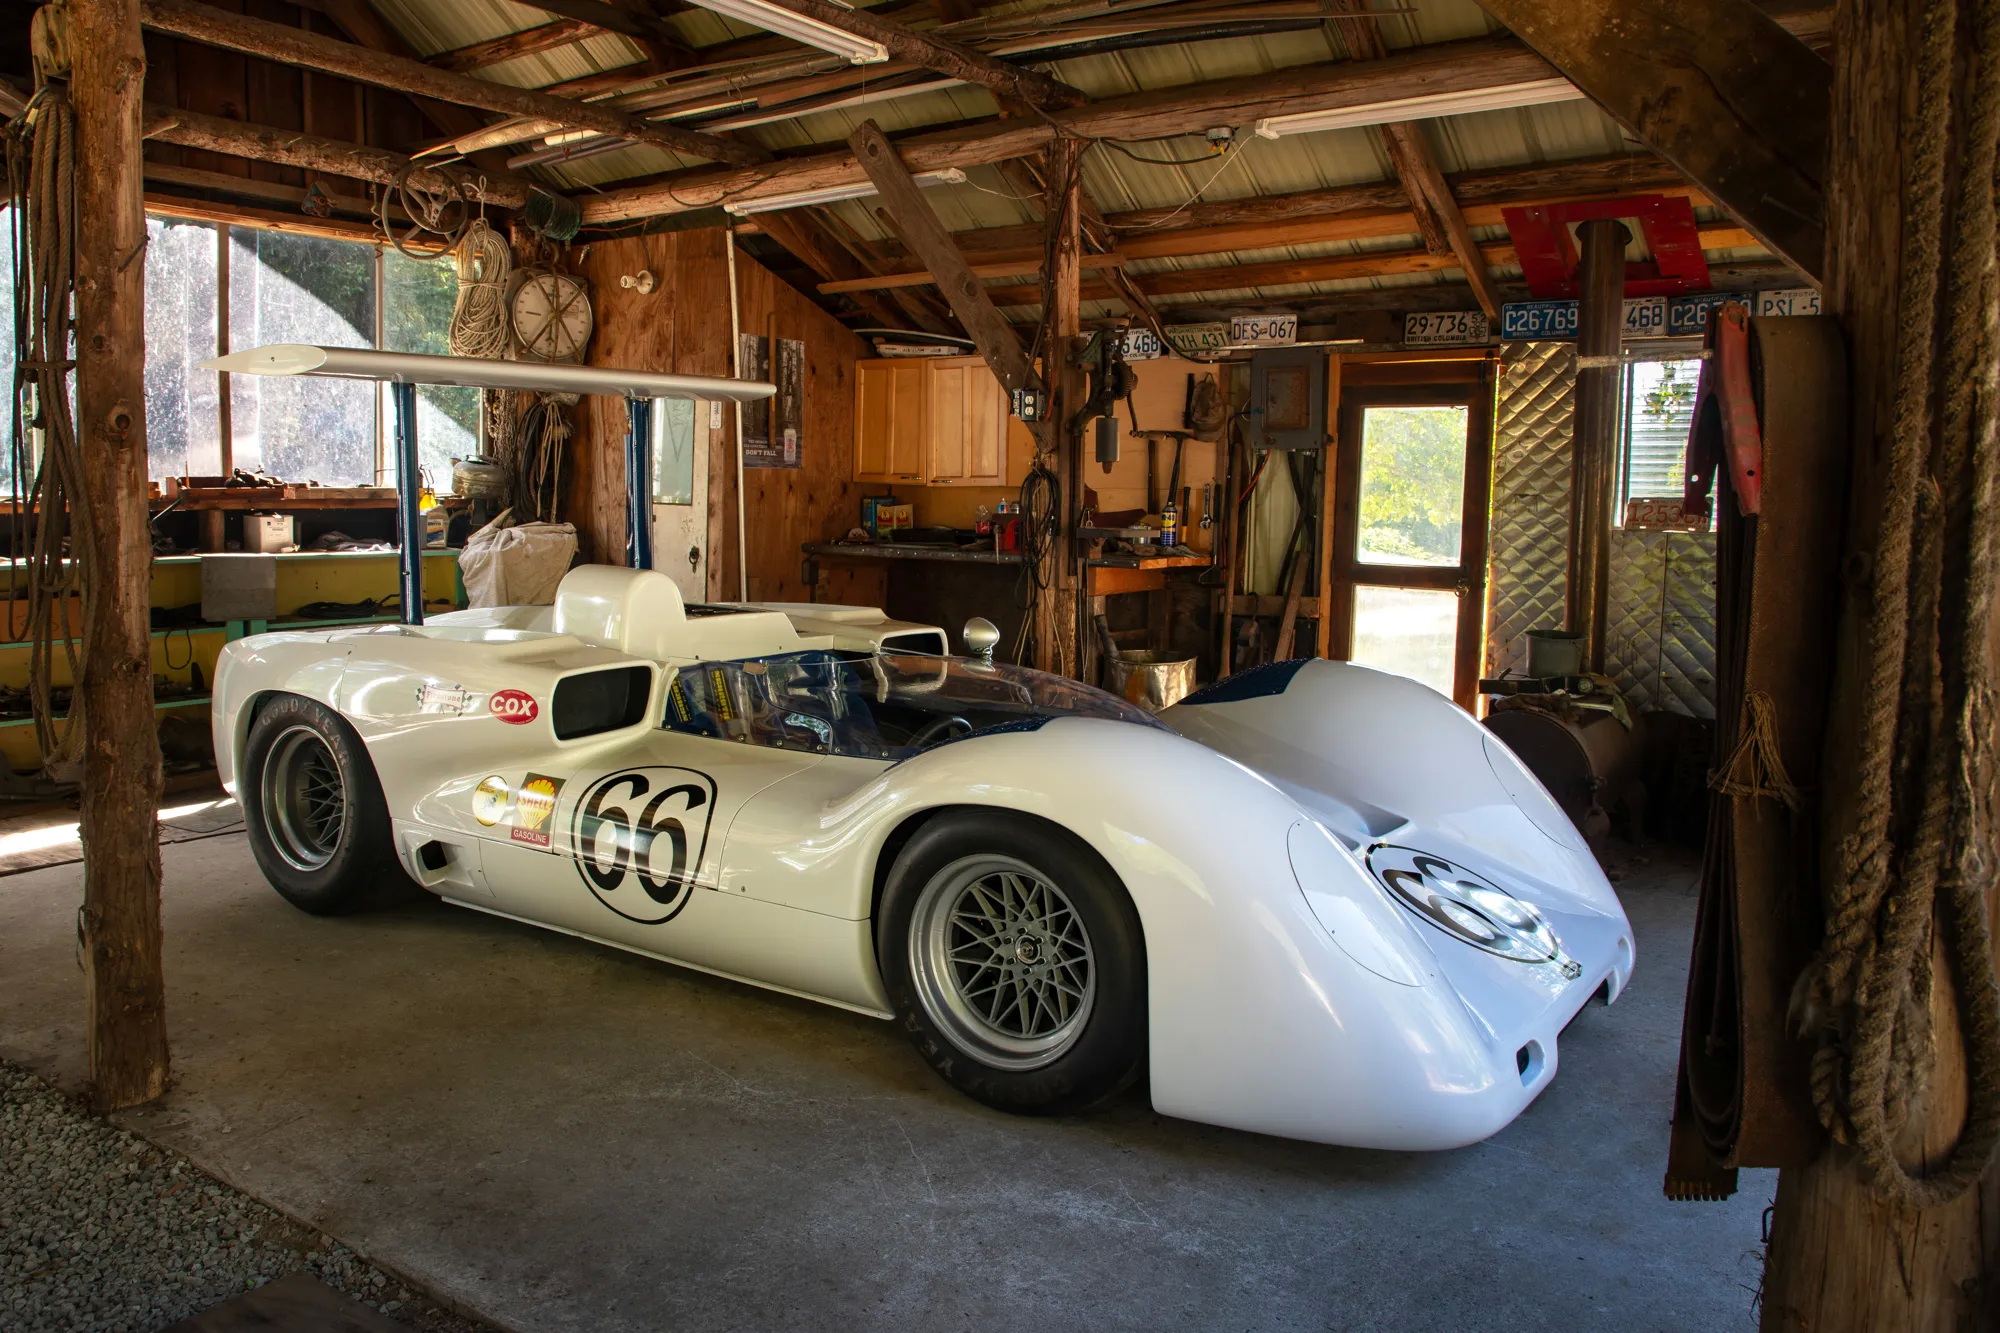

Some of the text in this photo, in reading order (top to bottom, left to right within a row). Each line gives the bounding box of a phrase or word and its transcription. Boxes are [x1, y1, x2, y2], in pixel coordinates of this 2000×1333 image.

[1626, 305, 1663, 328] 468
[1202, 332, 1227, 347] 431
[1233, 321, 1295, 340] DES 067
[1406, 335, 1432, 343] BRITISH
[1134, 335, 1159, 353] 468
[491, 695, 535, 717] COX
[521, 797, 549, 811] SHELL
[513, 829, 547, 844] GASOLINE
[581, 774, 706, 905] 66
[1382, 855, 1540, 952] 66
